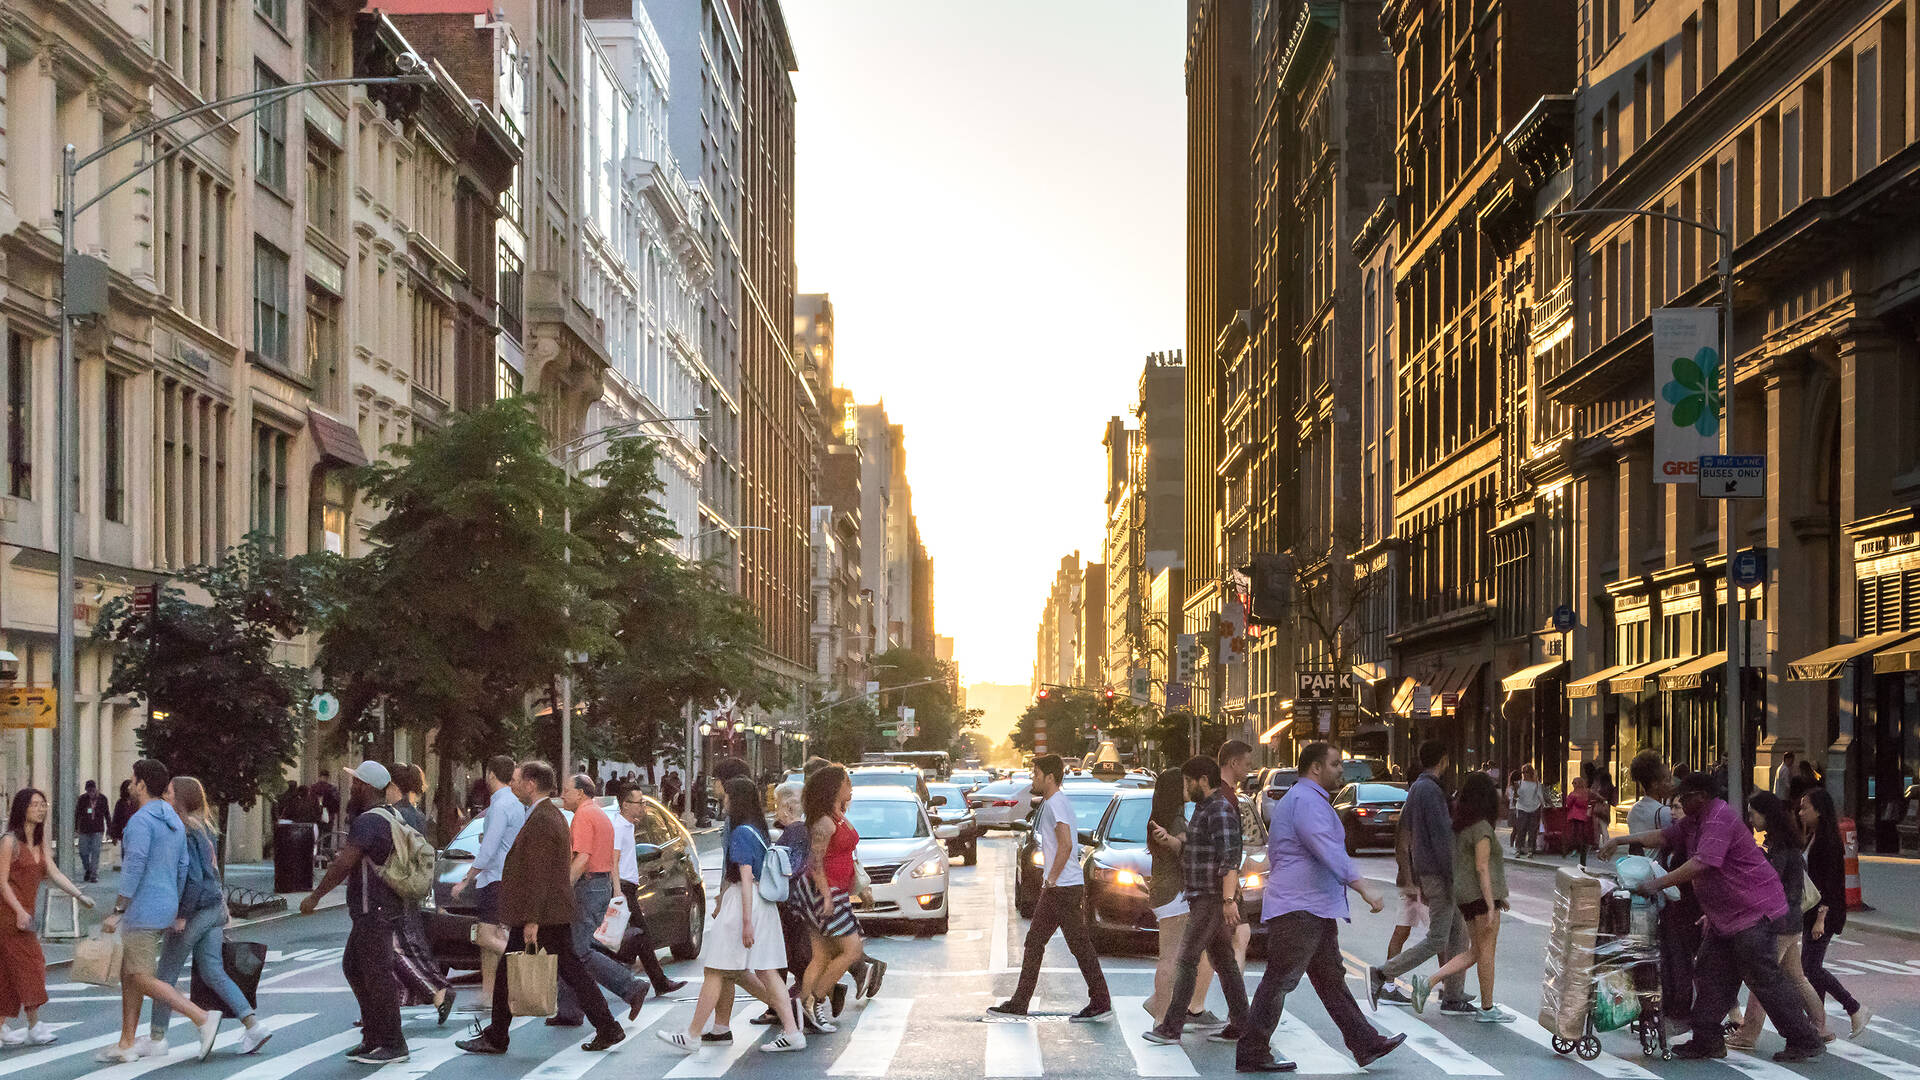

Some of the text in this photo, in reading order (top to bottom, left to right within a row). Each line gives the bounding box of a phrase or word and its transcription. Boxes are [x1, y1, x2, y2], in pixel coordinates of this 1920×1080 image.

[1662, 461, 1698, 475] GRE
[1703, 469, 1760, 478] BUSES ONLY
[1301, 674, 1351, 689] PARK
